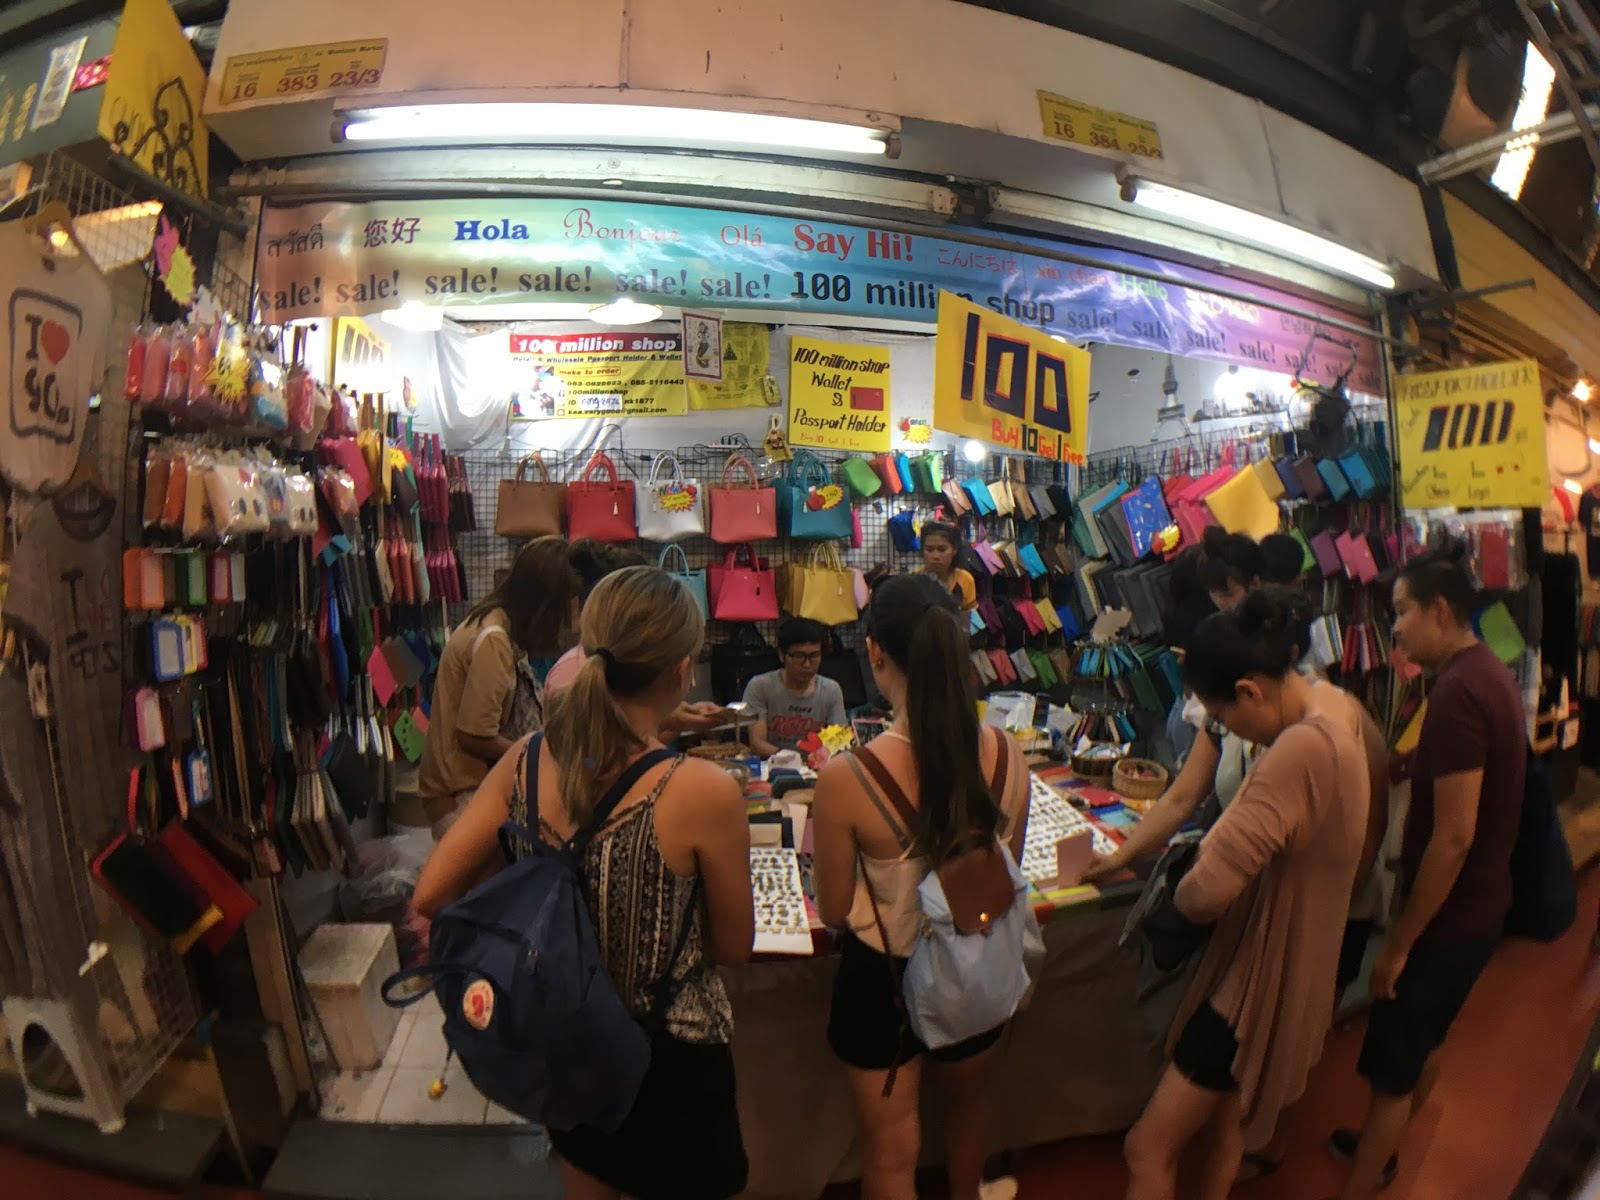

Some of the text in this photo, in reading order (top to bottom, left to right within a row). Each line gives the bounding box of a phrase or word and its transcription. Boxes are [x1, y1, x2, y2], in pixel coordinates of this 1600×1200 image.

[232, 82, 258, 100] 16
[276, 74, 319, 93] 383
[328, 69, 380, 88] 23/3
[1054, 121, 1075, 138] 16
[267, 223, 325, 257] สวัสดี
[363, 217, 421, 248] 您好
[453, 219, 530, 241] Hola
[563, 207, 682, 252] Bonjour
[720, 224, 763, 248] Olá
[794, 223, 913, 262] Say Hi!
[937, 248, 1019, 274] こんにちは
[258, 277, 321, 311] sale!
[335, 269, 400, 303] sale!
[425, 267, 498, 295] sale!
[518, 265, 592, 293] sale!
[615, 268, 688, 296] sale!
[700, 271, 771, 299] sale!
[790, 271, 851, 302] 100
[866, 280, 974, 310] milli
[986, 291, 1056, 326] shop
[1066, 308, 1119, 332] sale!
[1186, 327, 1227, 353] sale!
[1239, 339, 1276, 364] sale!
[559, 336, 624, 353] million
[631, 336, 677, 353] shop
[793, 347, 820, 365] 100
[587, 354, 620, 363] Passport
[622, 354, 648, 362] Holder
[658, 353, 683, 361] Wallet
[596, 367, 620, 375] order
[811, 371, 852, 391] Wallet
[961, 311, 1072, 434] 100
[793, 407, 887, 433] Passport Holder
[991, 417, 1084, 467] Buy 10 Get 1 Free
